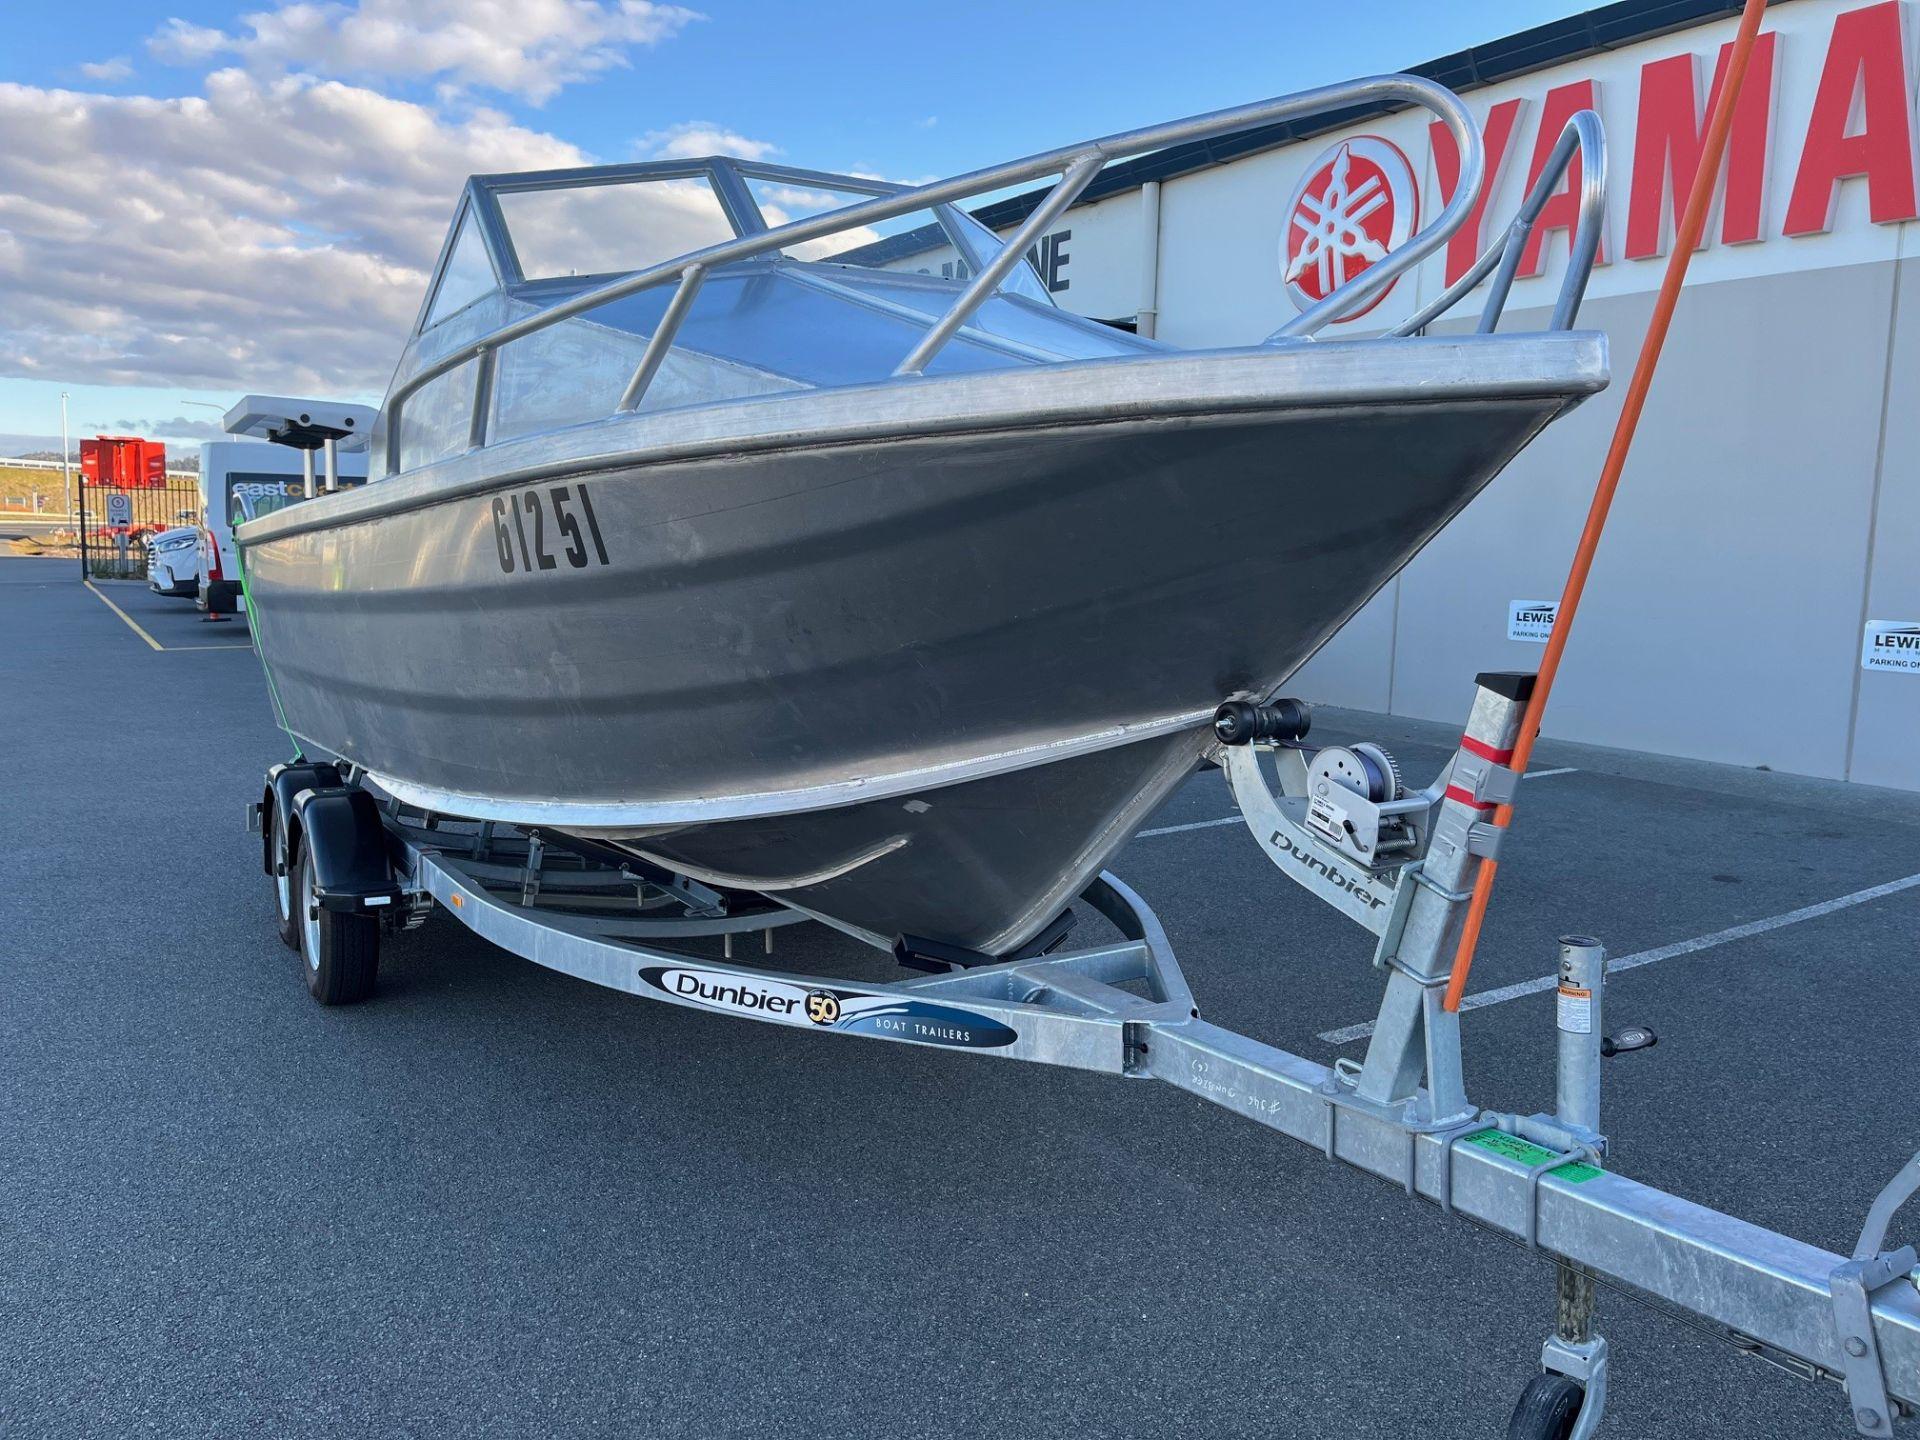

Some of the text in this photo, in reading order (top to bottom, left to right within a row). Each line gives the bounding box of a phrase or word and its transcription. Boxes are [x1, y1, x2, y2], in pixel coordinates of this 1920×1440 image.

[491, 484, 610, 574] 61251
[1870, 658, 1908, 667] PARKING
[1269, 830, 1387, 910] Dunbier
[676, 973, 801, 1015] Dunbier
[809, 996, 838, 1022] 50
[876, 1018, 970, 1042] BOAT TRAILERS
